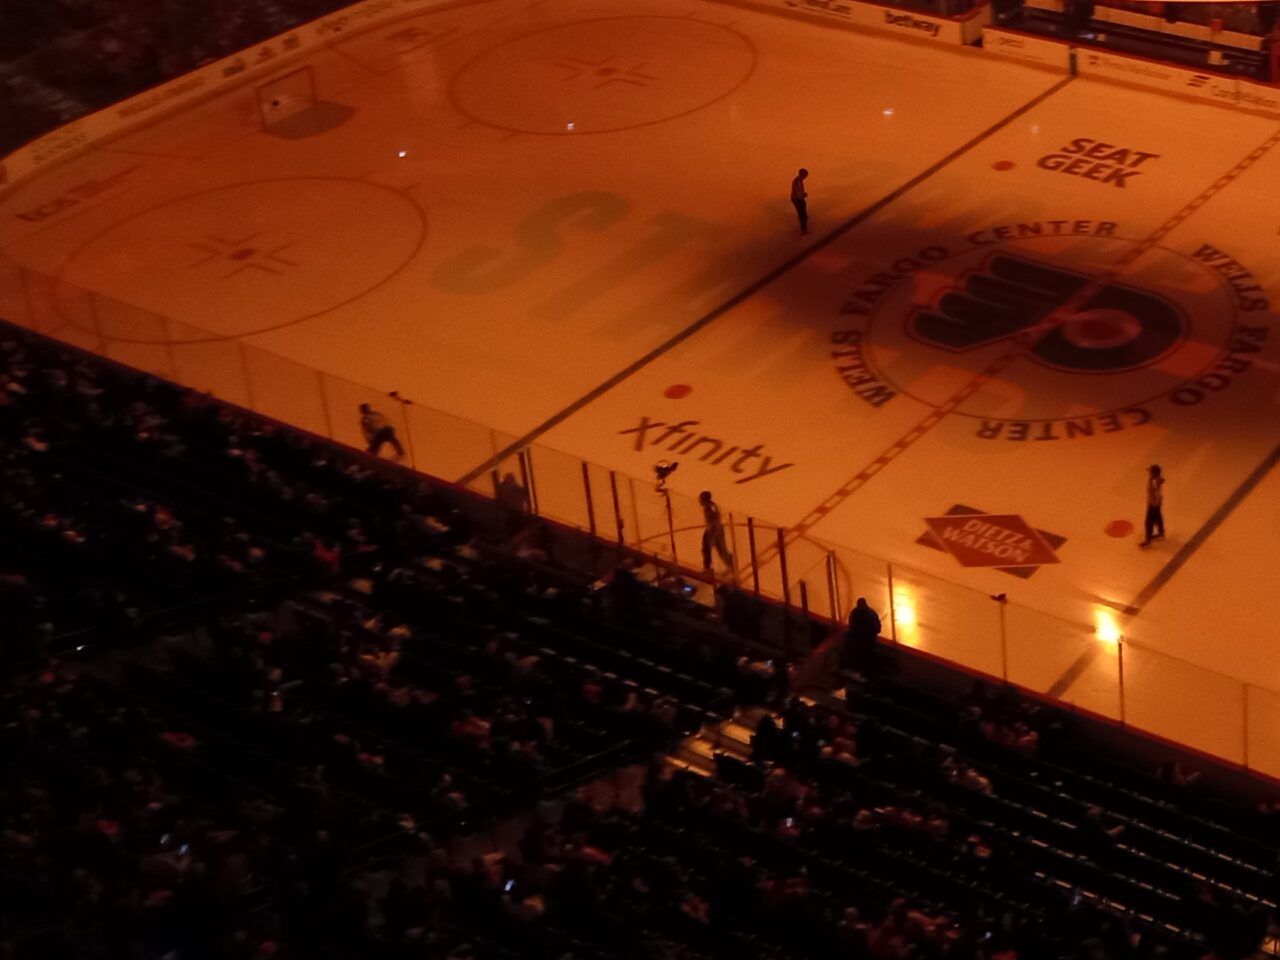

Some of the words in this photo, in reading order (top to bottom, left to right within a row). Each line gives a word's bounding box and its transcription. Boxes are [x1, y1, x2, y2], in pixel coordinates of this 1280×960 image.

[1036, 152, 1144, 189] GEEK
[1059, 137, 1159, 169] SEAT
[968, 219, 1118, 249] CENTER
[839, 245, 948, 318] FARGO
[1192, 244, 1268, 313] WELLS
[831, 330, 898, 408] WELLS
[1170, 325, 1268, 407] FARGO
[620, 416, 793, 485] xfinity
[975, 408, 1152, 442] CENTER
[939, 524, 1028, 563] WATSON
